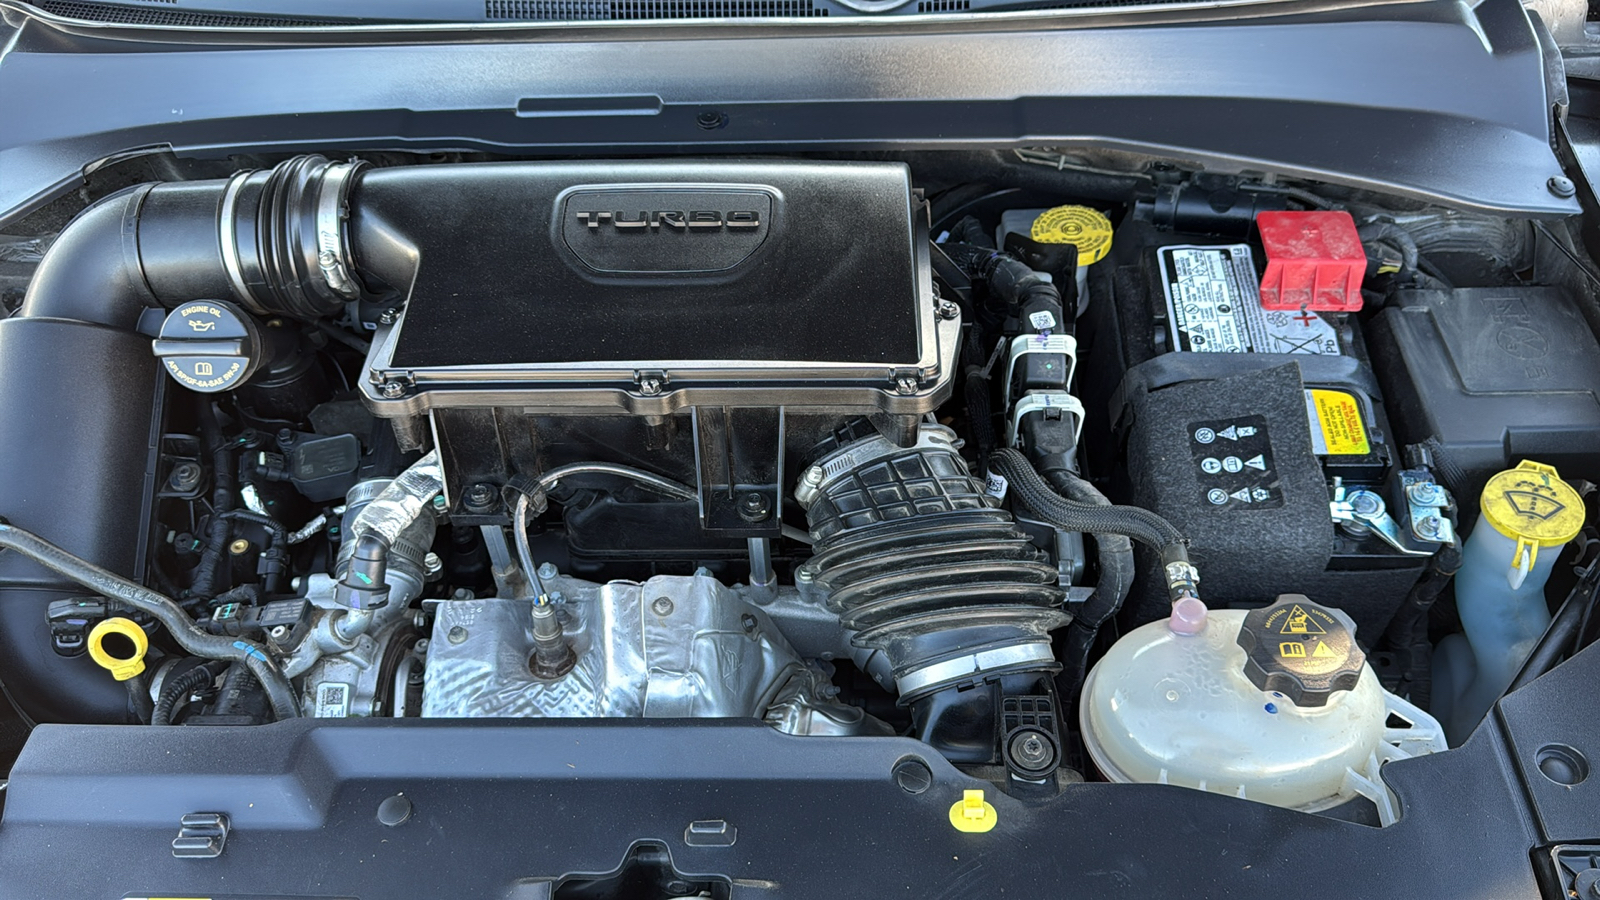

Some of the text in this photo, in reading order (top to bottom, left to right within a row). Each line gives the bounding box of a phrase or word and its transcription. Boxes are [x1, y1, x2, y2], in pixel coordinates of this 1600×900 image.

[576, 210, 760, 228] TURBO
[181, 306, 221, 318] ENGINE OIL
[1326, 339, 1337, 354] Pb
[167, 360, 178, 373] API
[223, 362, 240, 379] 5W-30
